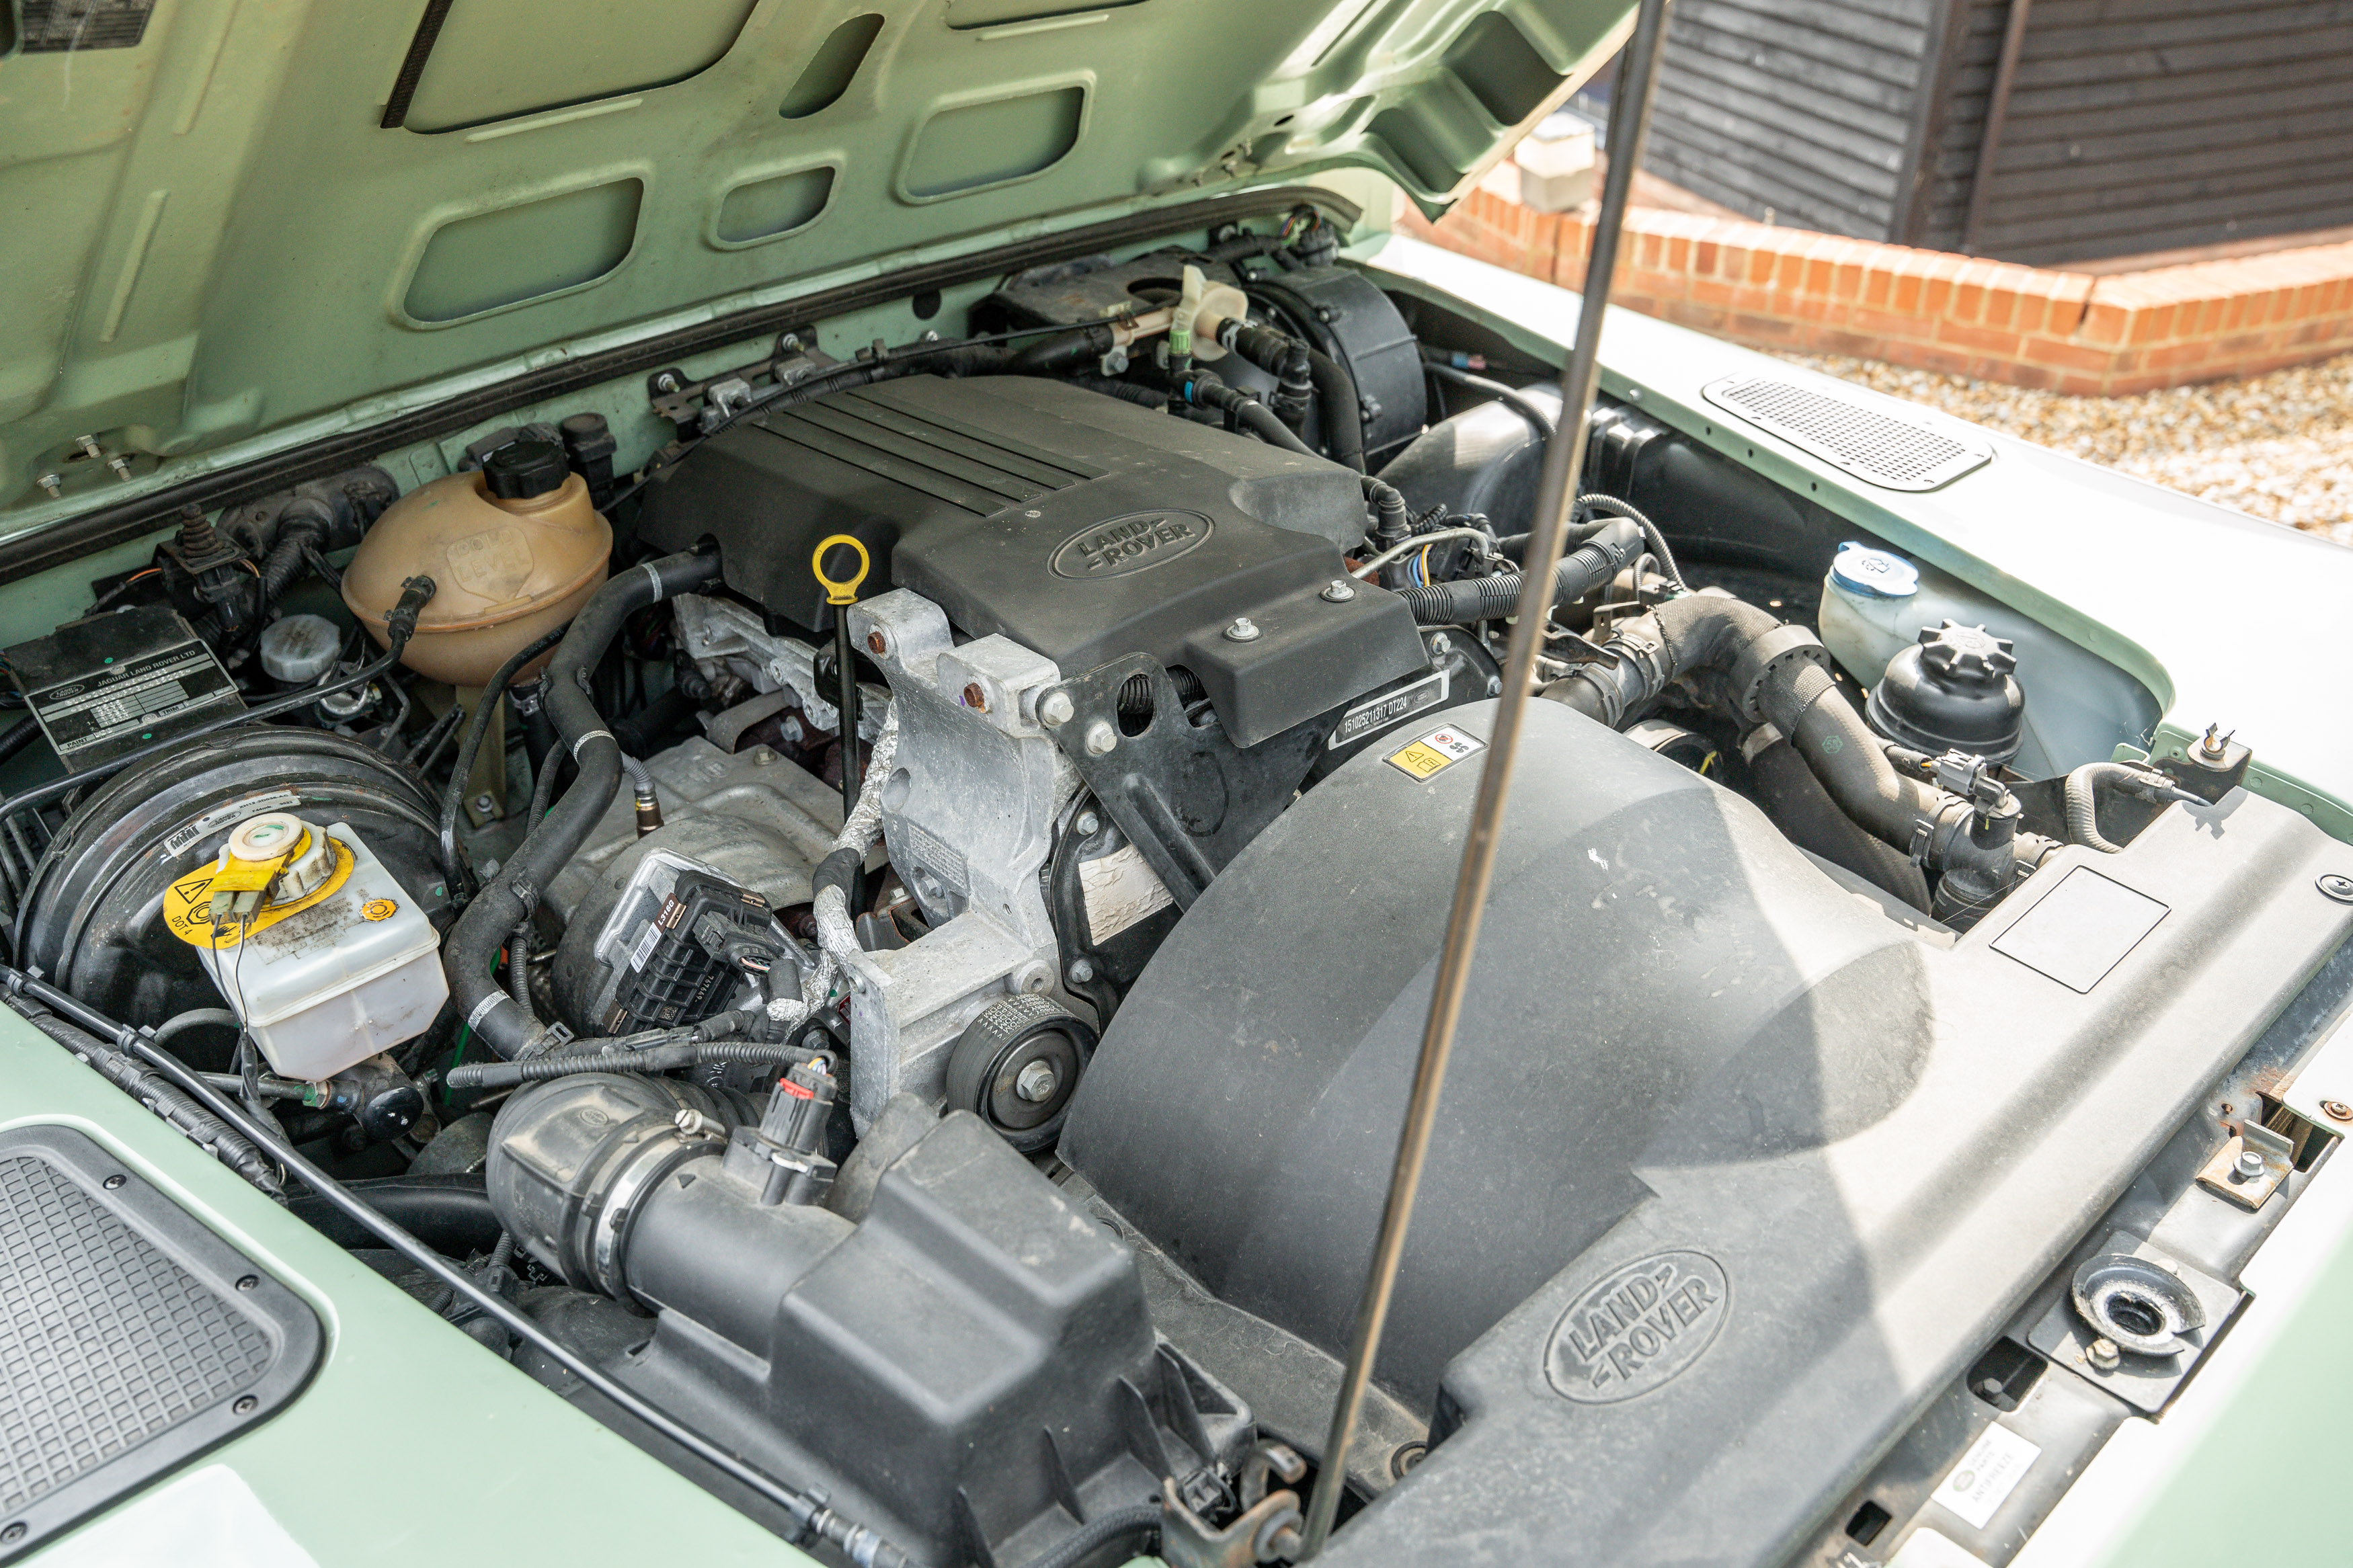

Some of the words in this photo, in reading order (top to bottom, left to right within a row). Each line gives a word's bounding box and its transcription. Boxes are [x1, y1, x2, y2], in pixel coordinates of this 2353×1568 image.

[457, 529, 513, 558] COLD
[1077, 520, 1151, 557] LAND
[1103, 524, 1197, 567] ROVER
[457, 548, 530, 583] LEVEL
[97, 672, 130, 687] JAGUAR
[130, 665, 152, 676] LAND
[153, 656, 180, 668] ROVER
[180, 650, 196, 659] LTD
[162, 705, 180, 714] TRIM
[1344, 704, 1387, 734] 151025211317
[1388, 695, 1408, 716] DT224
[66, 737, 88, 747] PAINT
[213, 814, 236, 827] ROVER
[214, 812, 233, 823] LAND
[171, 915, 188, 931] DOT
[184, 928, 193, 936] 4
[657, 899, 675, 926] L316G
[1569, 1276, 1659, 1361] LAND
[1607, 1278, 1718, 1380] ROVER
